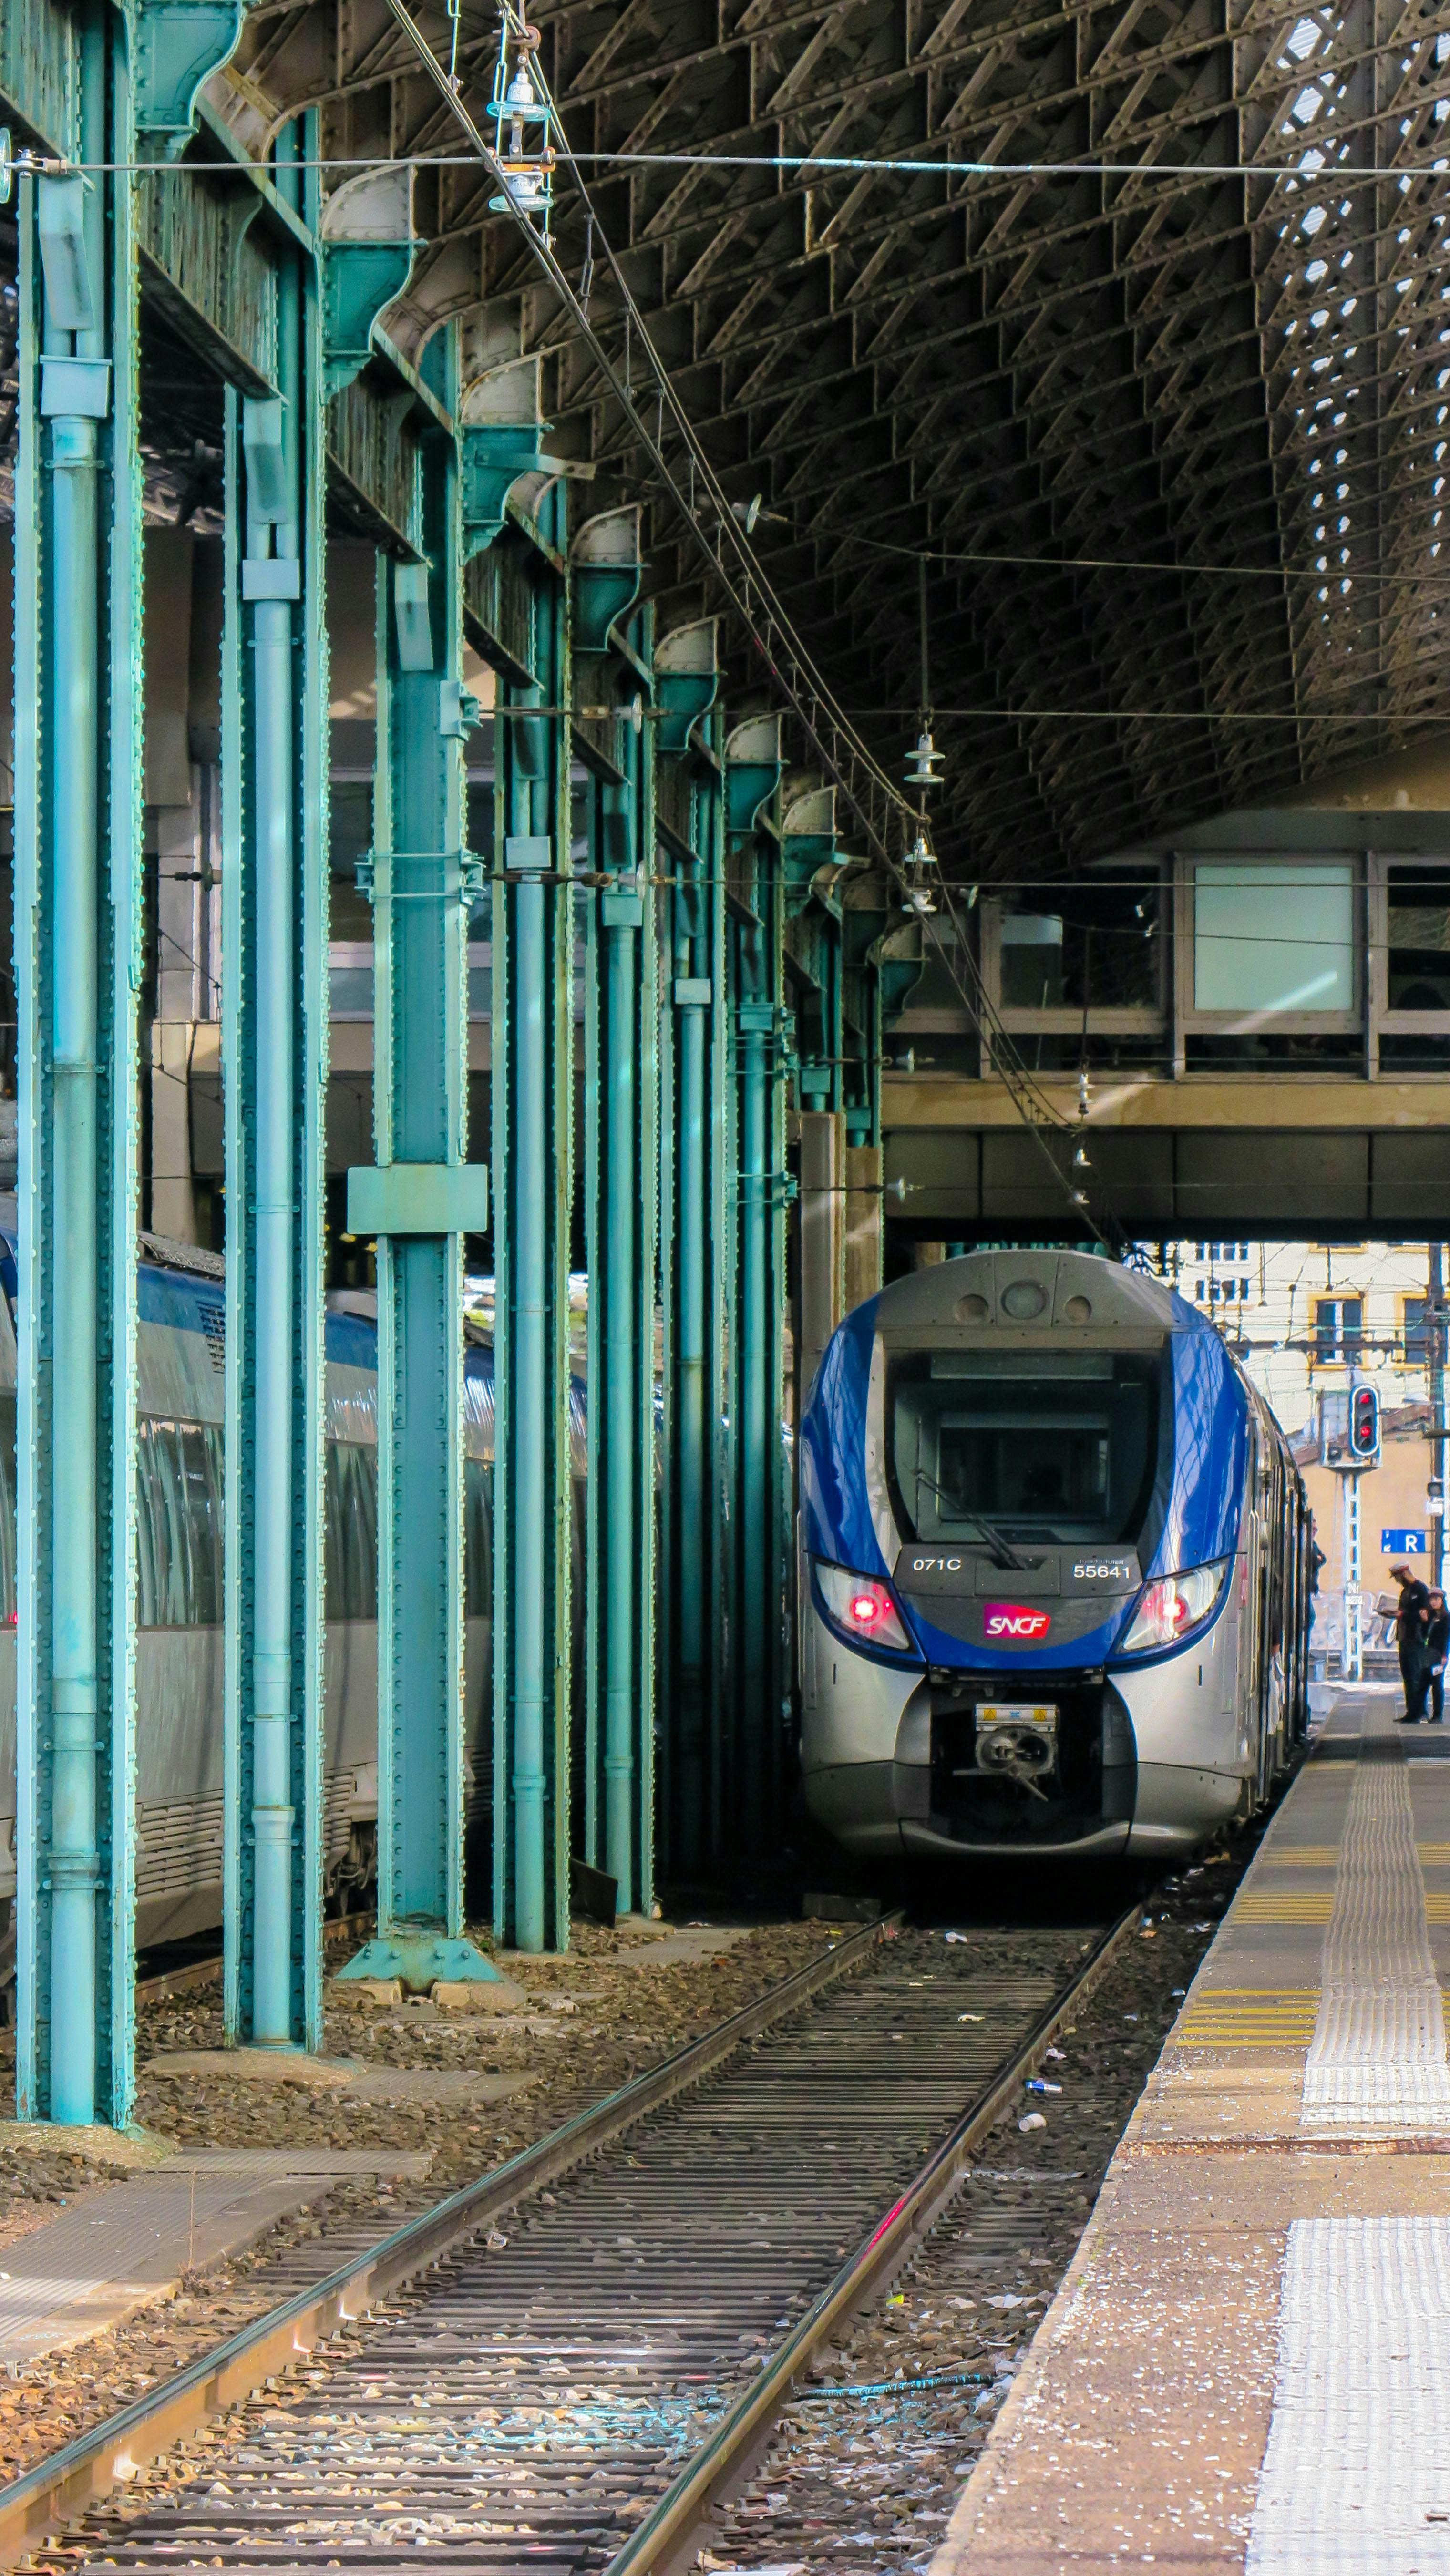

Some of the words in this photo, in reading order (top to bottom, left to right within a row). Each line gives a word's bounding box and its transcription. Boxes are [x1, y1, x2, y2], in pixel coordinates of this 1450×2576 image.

[1405, 1534, 1418, 1552] R
[913, 1559, 962, 1570] 071C
[1073, 1565, 1130, 1578] 55641
[986, 1617, 1046, 1634] SNCF
